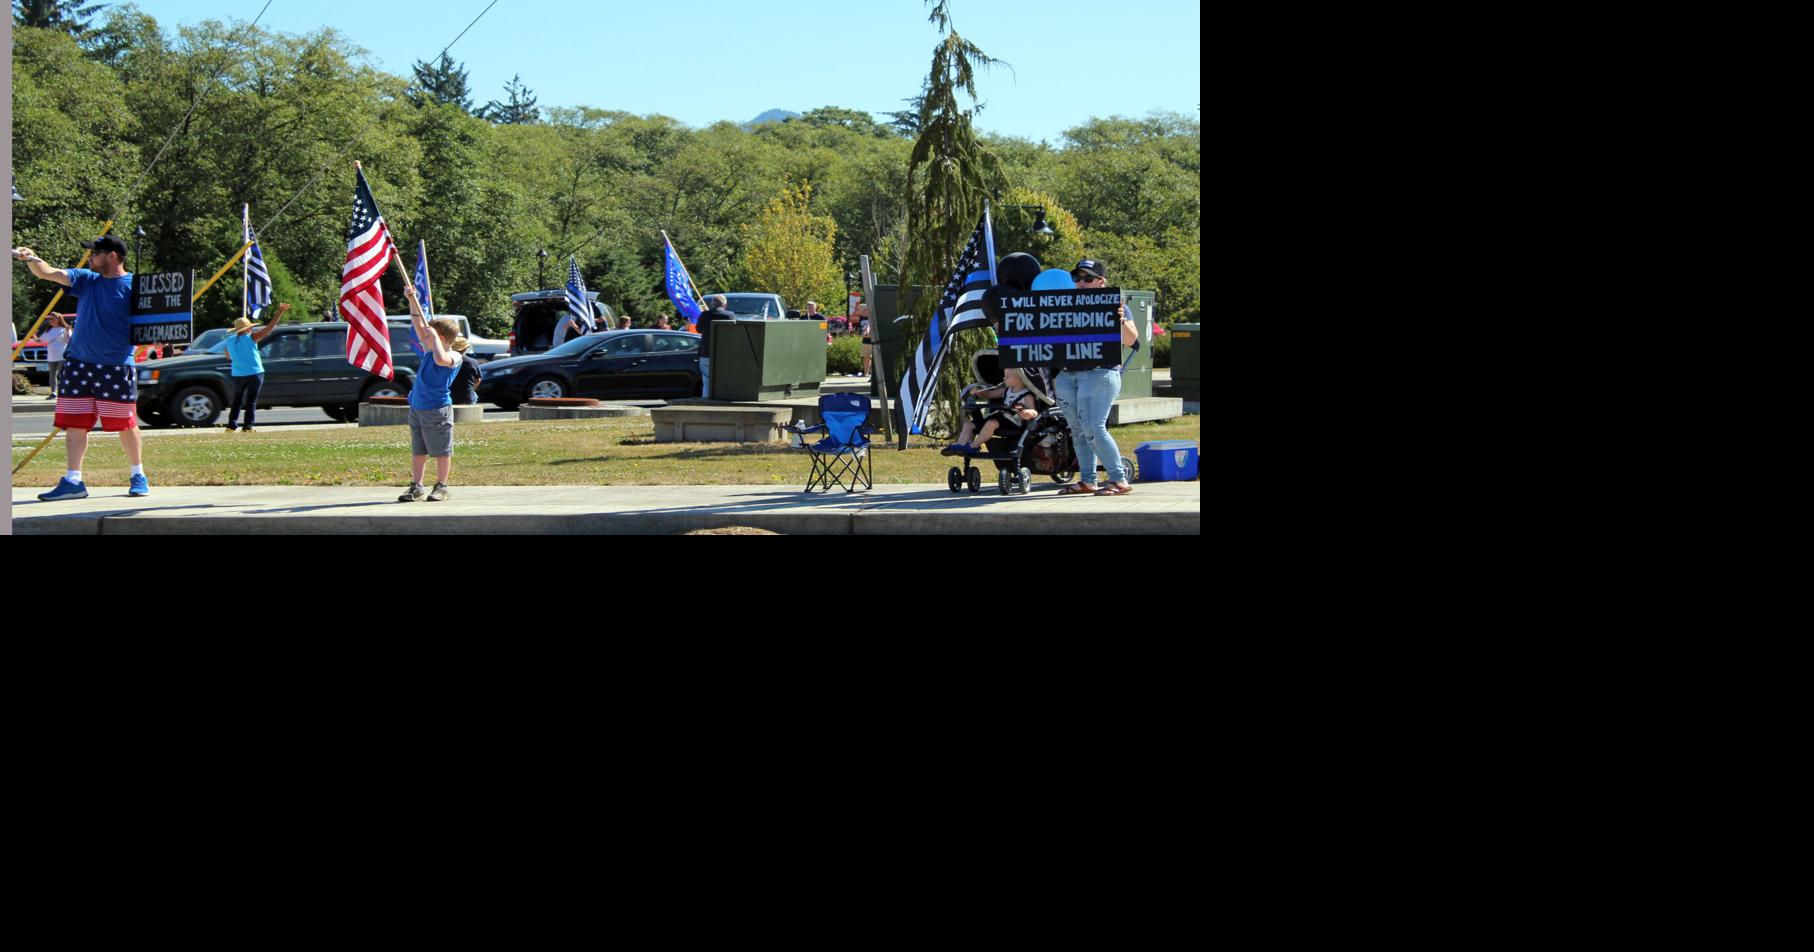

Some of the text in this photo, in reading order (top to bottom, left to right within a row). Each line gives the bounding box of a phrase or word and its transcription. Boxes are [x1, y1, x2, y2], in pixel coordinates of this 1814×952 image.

[139, 272, 185, 294] BLESSED
[138, 294, 181, 309] ARE THE
[1000, 293, 1120, 309] I WILL NEVER APOLOGIZE
[1004, 311, 1115, 332] FOR DEFENDING
[134, 324, 188, 342] PEACEMAKERS
[1010, 342, 1103, 362] THIS LINE
